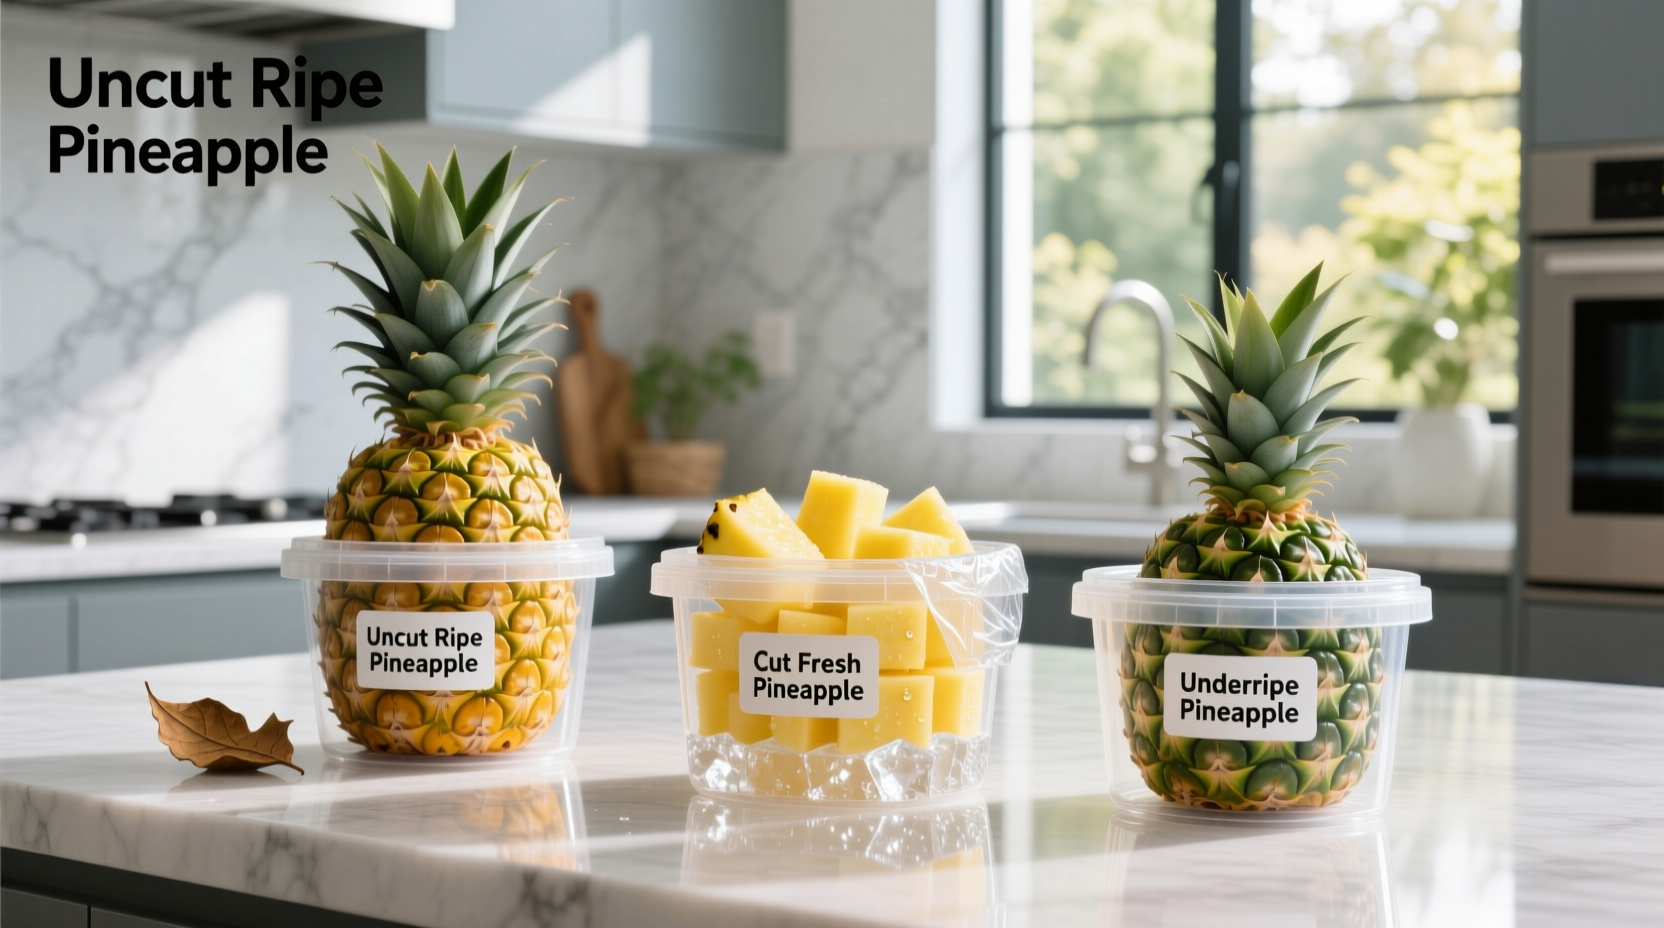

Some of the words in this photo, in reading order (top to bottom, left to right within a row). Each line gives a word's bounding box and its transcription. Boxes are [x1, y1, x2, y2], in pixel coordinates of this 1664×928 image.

[367, 626, 429, 649] Uncut
[435, 626, 483, 654] Ripe
[370, 652, 478, 678] Pineapple
[753, 650, 792, 674] Cut
[798, 650, 861, 674] Fresh
[753, 677, 864, 706] Pineapple
[1180, 671, 1299, 701] Underripe
[1180, 697, 1299, 729] Pineapple
